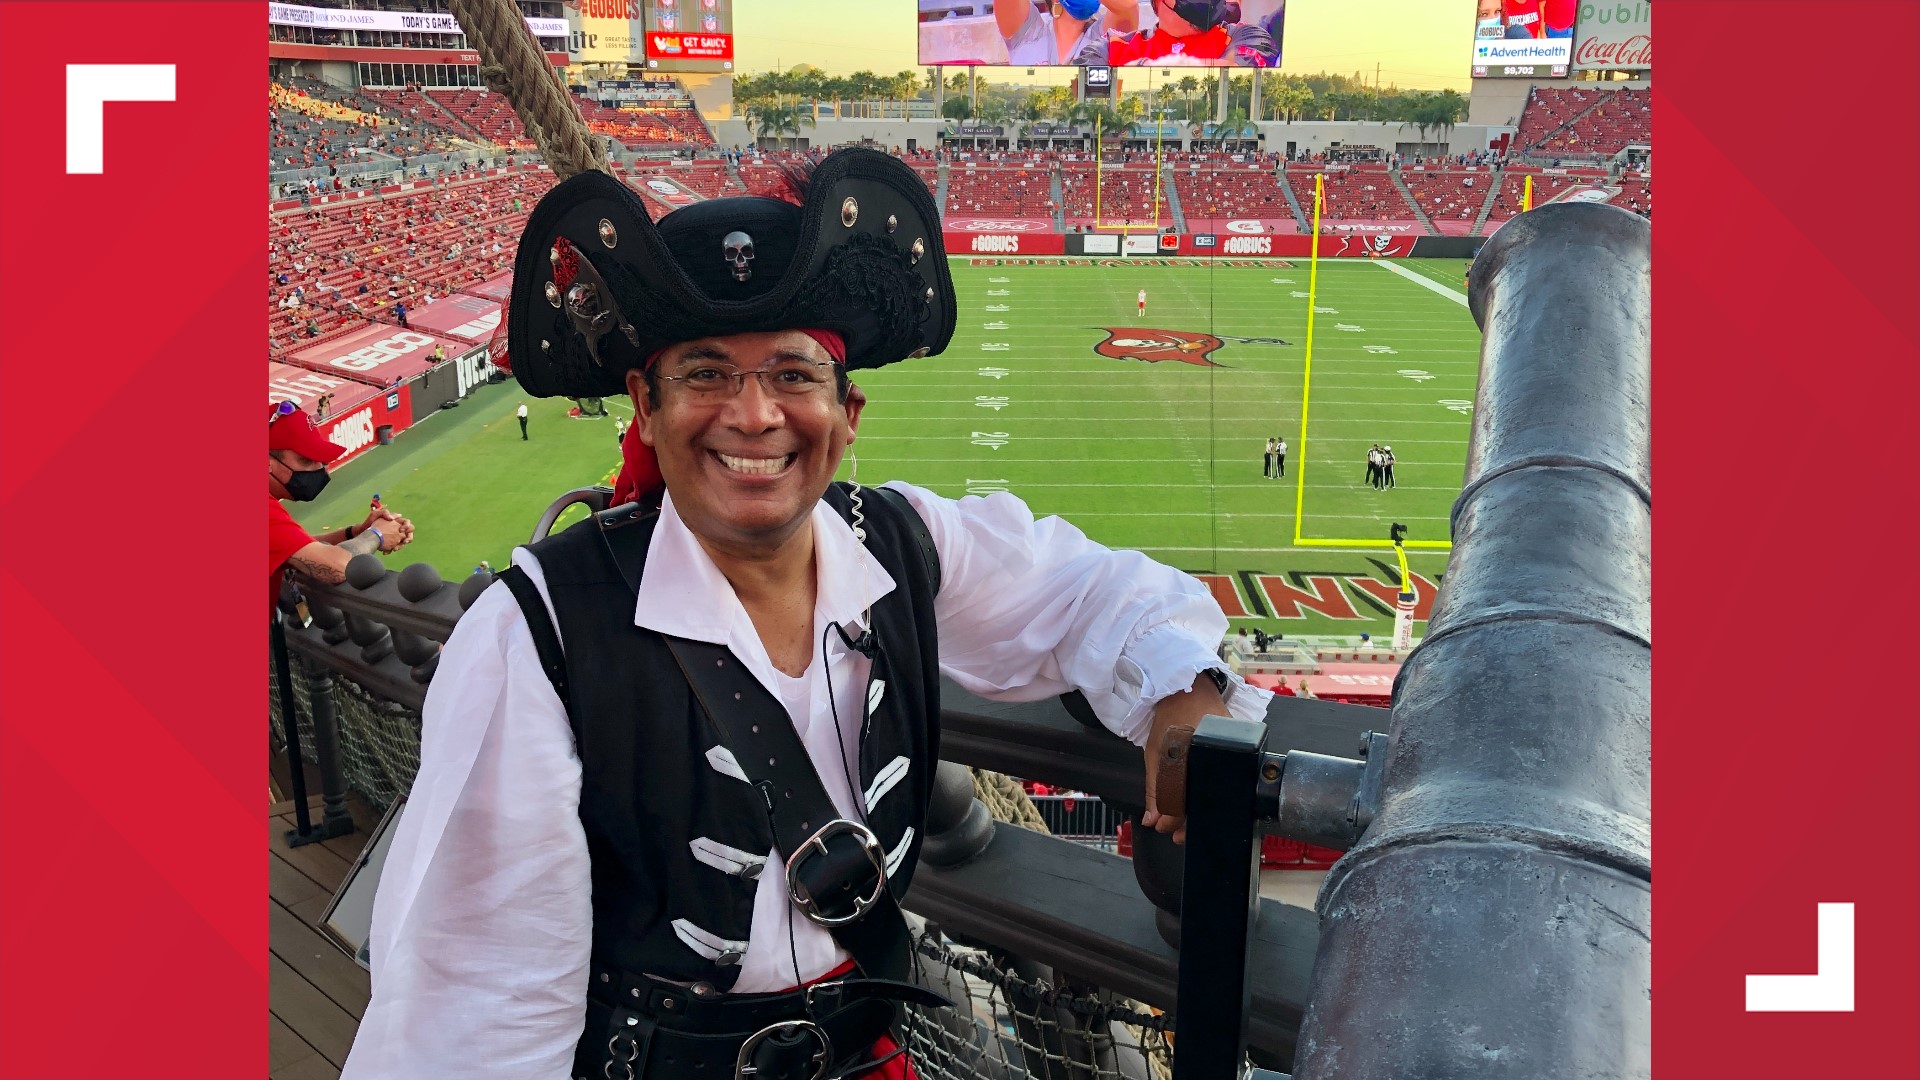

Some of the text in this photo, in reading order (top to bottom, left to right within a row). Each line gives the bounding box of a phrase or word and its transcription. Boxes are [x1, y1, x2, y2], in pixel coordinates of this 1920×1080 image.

[401, 16, 430, 29] TODAY'S
[432, 17, 452, 29] GAME
[540, 23, 563, 31] JAMES
[1478, 26, 1503, 37] #GOBUCS
[683, 37, 699, 47] GET
[701, 37, 726, 48] SAUCY.
[460, 54, 475, 62] TEXT
[1089, 69, 1108, 81] 25
[1504, 66, 1535, 75] $9,702
[1324, 223, 1402, 232] verizon
[972, 235, 1019, 252] #GOBUCS
[1163, 236, 1176, 247] 25
[1223, 236, 1272, 254] #GOBUCS
[329, 331, 435, 371] GEICO
[971, 431, 1010, 446] 20
